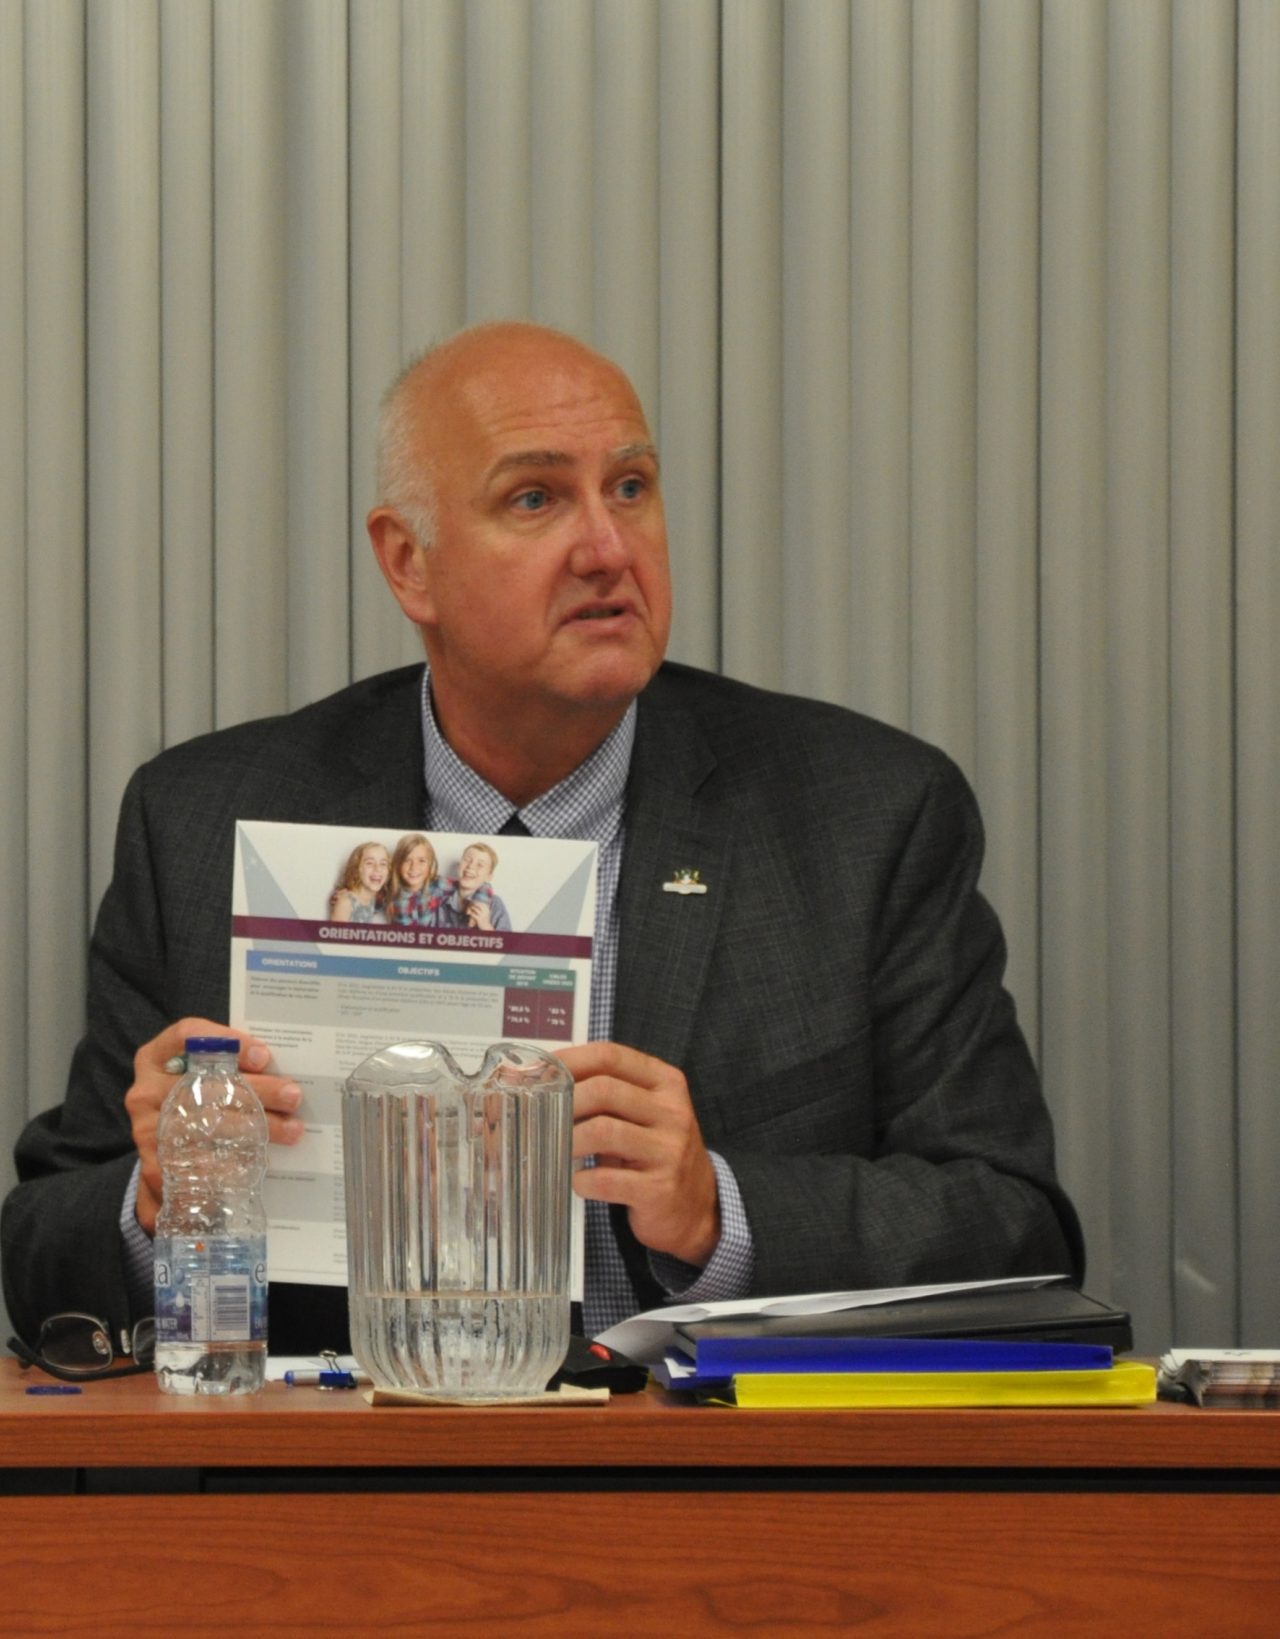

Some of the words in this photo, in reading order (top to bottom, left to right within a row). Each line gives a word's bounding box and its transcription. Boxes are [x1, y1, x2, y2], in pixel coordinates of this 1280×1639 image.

[318, 926, 416, 945] ORIENTATIONS
[418, 932, 433, 945] ET
[436, 933, 504, 949] OBJECTIFS
[261, 957, 318, 969] ORIENTATIONS
[397, 965, 440, 977] OBJECTIFS
